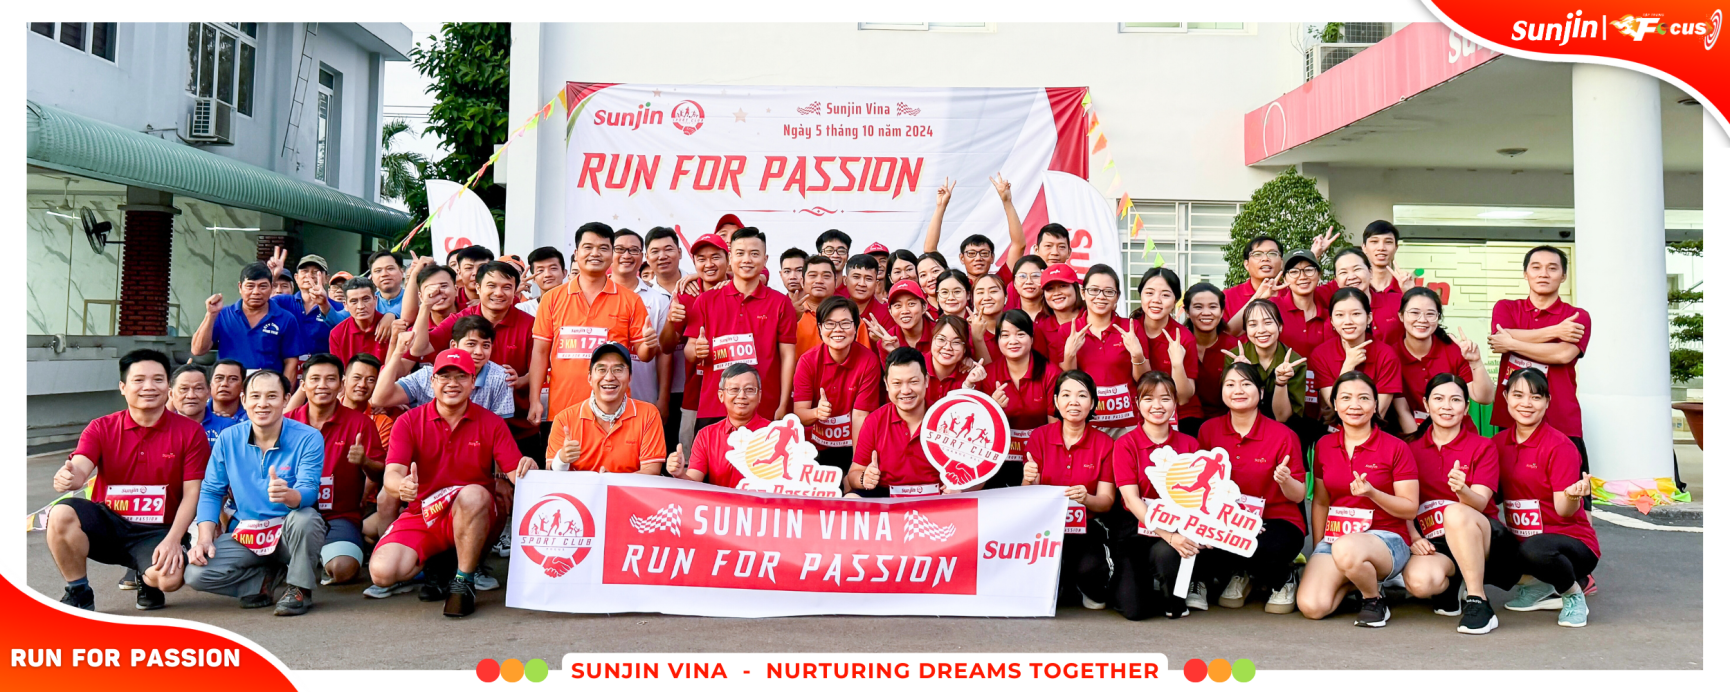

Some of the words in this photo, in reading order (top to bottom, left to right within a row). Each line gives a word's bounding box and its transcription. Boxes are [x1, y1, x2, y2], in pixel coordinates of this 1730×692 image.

[594, 101, 664, 131] Sunjin
[826, 102, 862, 117] Sunjin
[865, 102, 890, 115] Vina
[783, 123, 812, 139] Ngày
[816, 124, 822, 137] 5
[826, 124, 859, 140] tháng
[862, 125, 874, 137] 10
[878, 124, 902, 137] năm
[905, 125, 933, 137] 2024
[576, 152, 662, 197] RUN
[669, 155, 748, 199] FOR
[759, 156, 925, 200] PASSION
[559, 339, 564, 348] 3
[565, 339, 577, 348] KM
[729, 344, 753, 358] 100
[1106, 396, 1131, 411] 058
[825, 425, 850, 438] 005
[926, 431, 965, 449] SPORT
[970, 445, 1000, 461] CLUB
[799, 464, 837, 485] Run
[114, 500, 129, 511] KM
[133, 498, 163, 512] 129
[424, 507, 429, 518] 3
[430, 501, 444, 515] KM
[693, 504, 803, 539] SUNJIN
[819, 510, 893, 541] VINA
[1216, 503, 1257, 531] Run
[1512, 512, 1540, 525] 062
[1150, 503, 1181, 527] for
[1183, 514, 1253, 552] Passion
[1330, 521, 1341, 532] KM
[1420, 520, 1426, 530] 3
[240, 534, 254, 545] KM
[521, 536, 557, 545] SPORT
[563, 538, 592, 546] CLUB
[621, 544, 695, 580] RUN
[711, 549, 782, 584] FOR
[799, 552, 957, 588] PASSION
